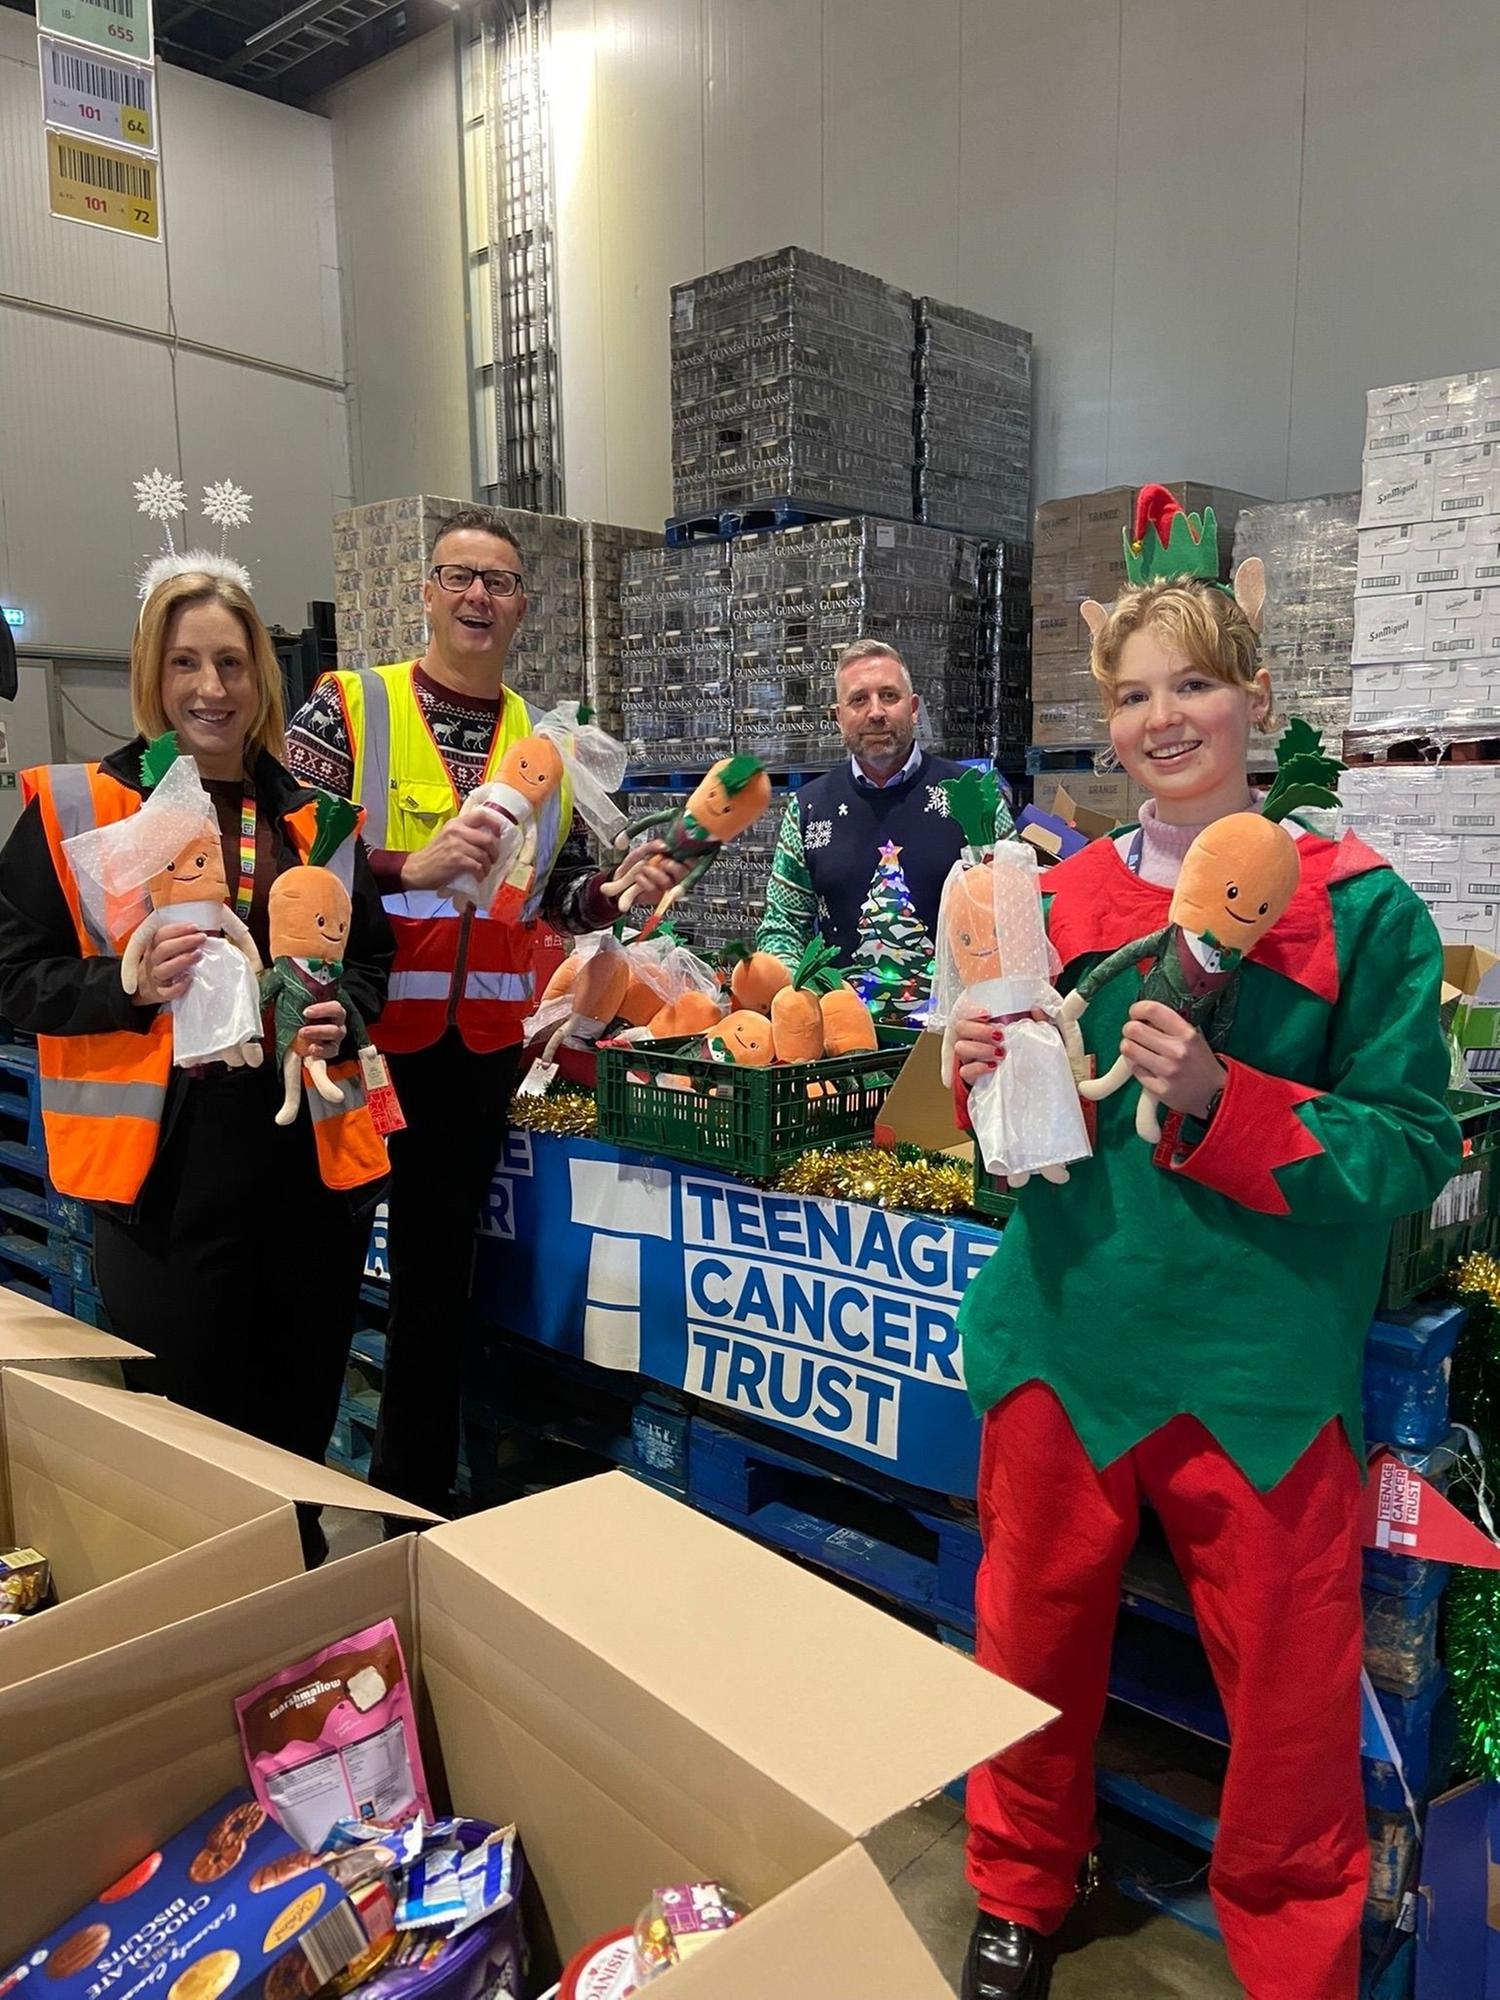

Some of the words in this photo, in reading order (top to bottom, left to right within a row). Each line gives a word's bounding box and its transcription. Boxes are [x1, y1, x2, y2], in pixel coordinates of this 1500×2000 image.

[108, 24, 134, 42] 655
[78, 104, 101, 121] 101
[127, 119, 145, 134] 64
[85, 196, 107, 213] 101
[134, 208, 150, 223] 72
[711, 403, 747, 419] GUINNESS
[752, 393, 791, 409] GUINNESS
[711, 463, 747, 479] GUINNESS
[752, 455, 791, 470] GUINNESS
[775, 542, 816, 557] GUINNESS
[821, 536, 863, 549] GUINNESS
[732, 607, 770, 621] GUINNESS
[775, 603, 815, 616] GUINNESS
[820, 599, 861, 611] GUINNESS
[734, 667, 771, 678] GUINNESS
[776, 663, 815, 675] GUINNESS
[734, 723, 771, 734] GUINNESS
[776, 722, 815, 733] GUINNESS
[687, 1183, 1000, 1292] TEENAGE
[690, 1258, 960, 1380] CANCER
[692, 1331, 894, 1445] TRUST
[1380, 1464, 1394, 1517] TEENAGE
[1393, 1470, 1407, 1521] CANCER
[1407, 1483, 1419, 1522] TRUST
[269, 1679, 341, 1719] marshmallow
[85, 1895, 210, 2000] CHOCOLATE
[97, 1898, 187, 1971] BISCUITS
